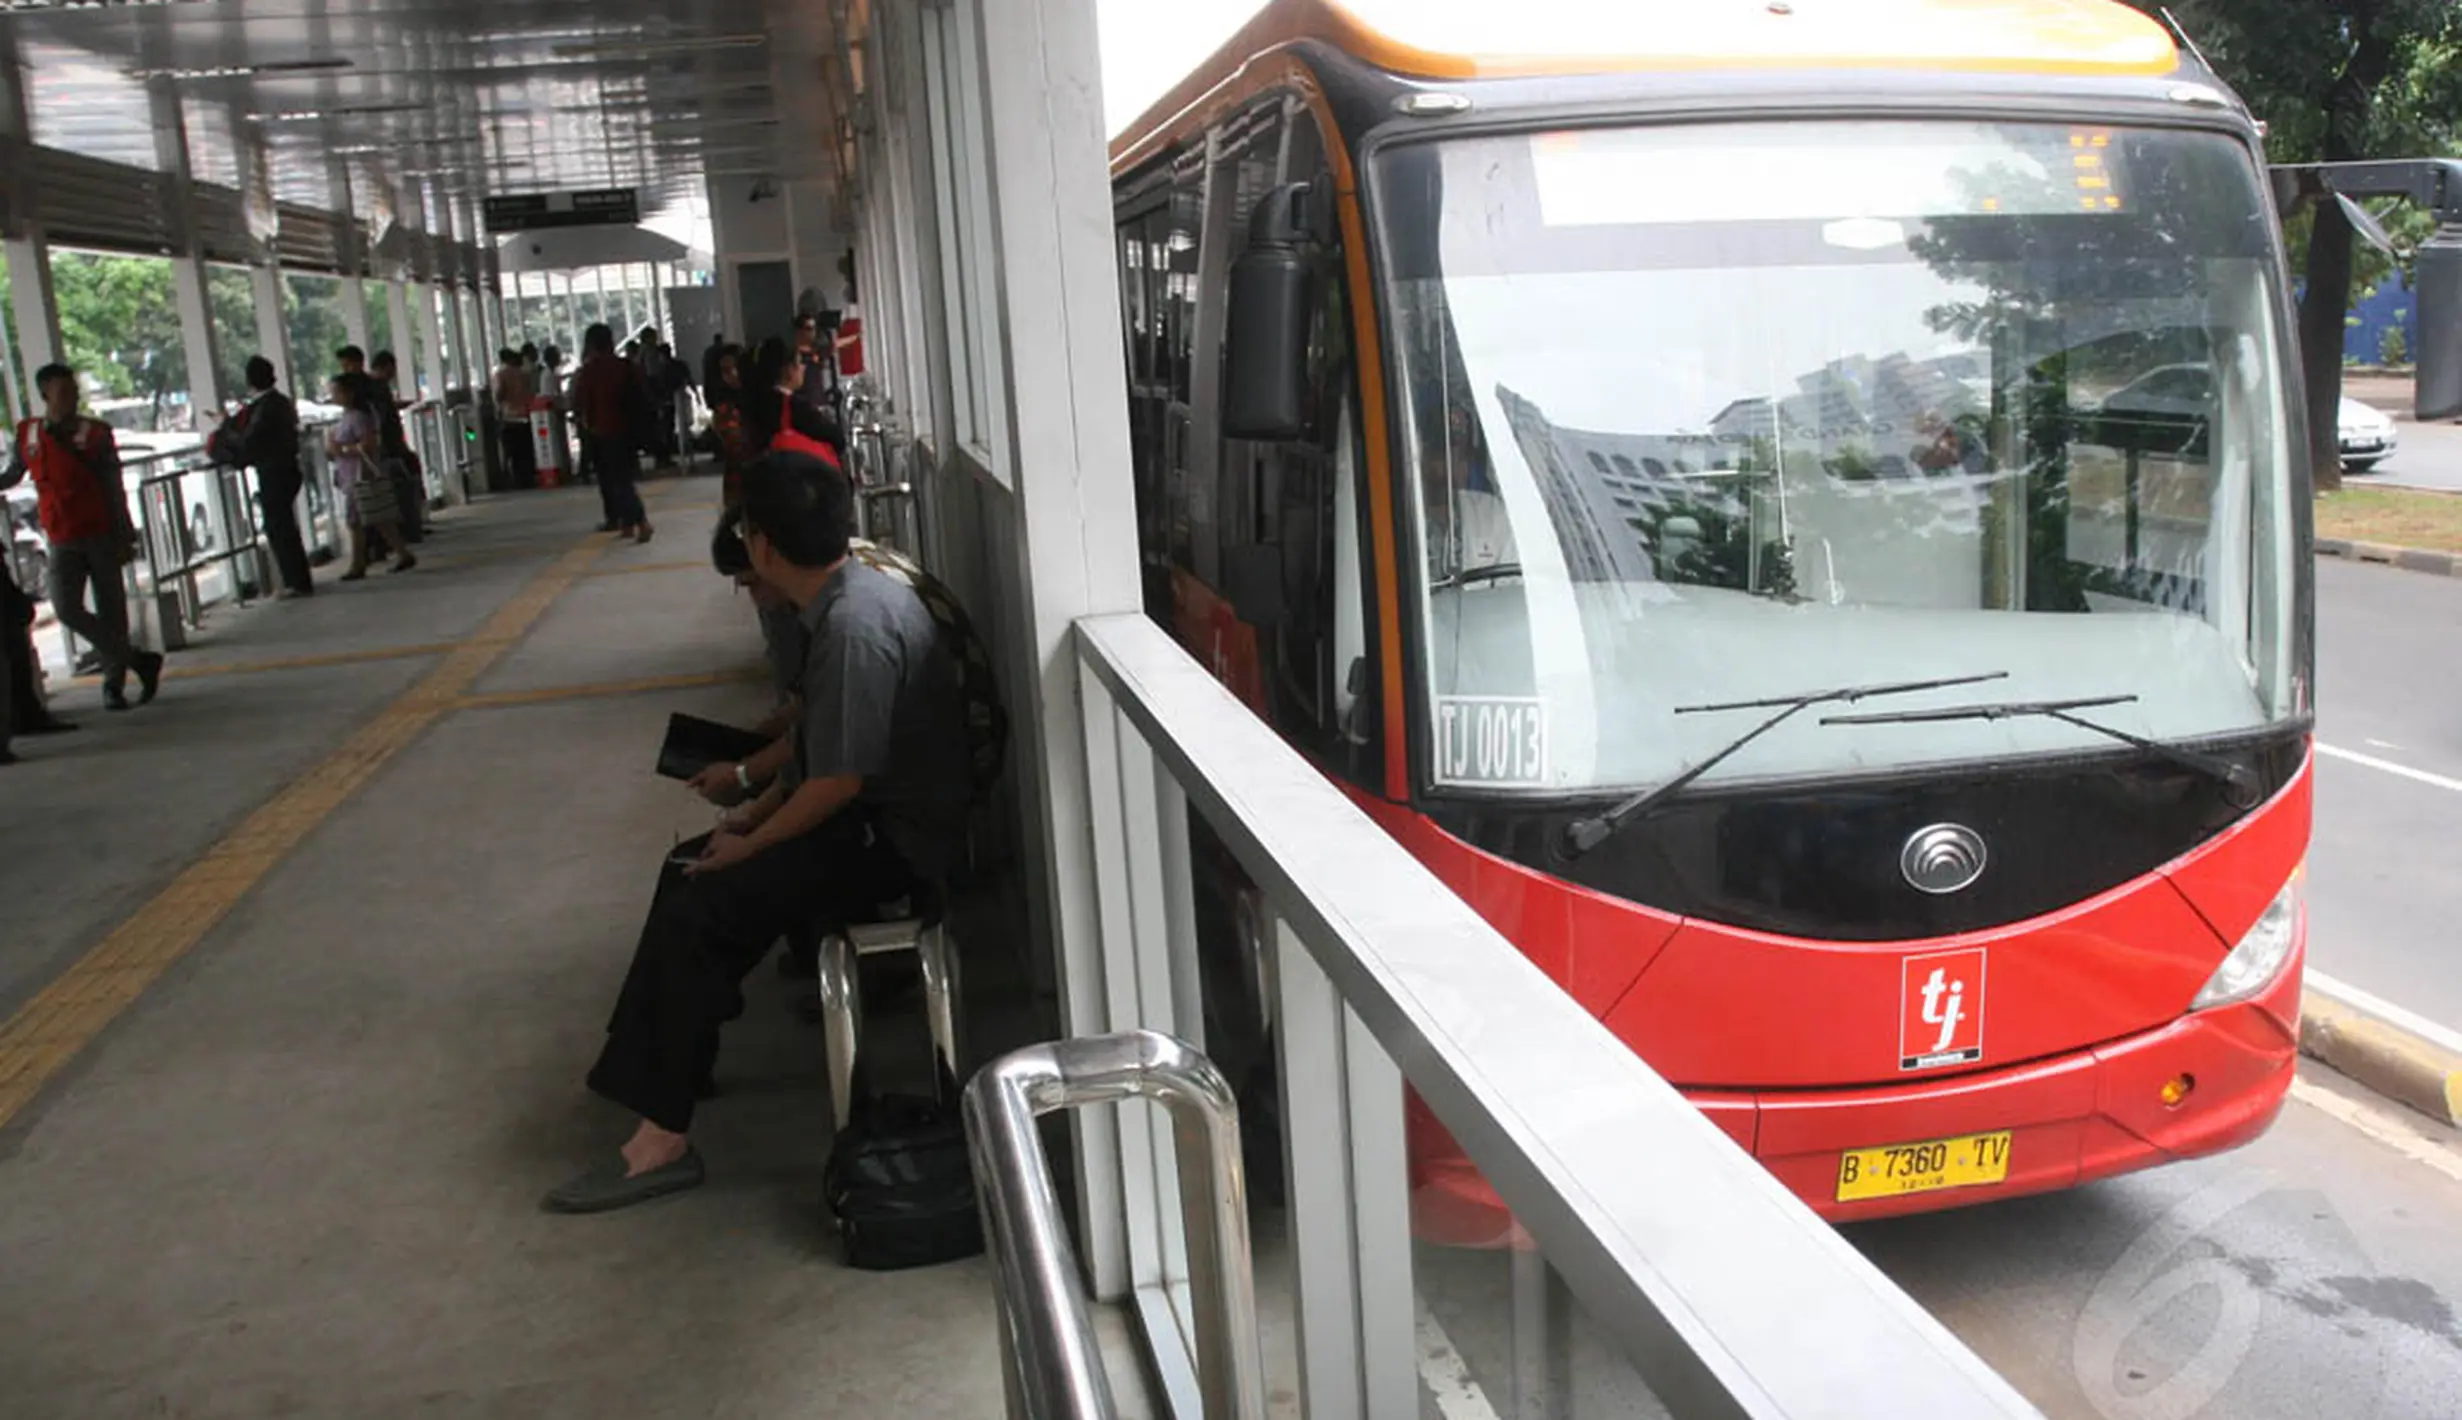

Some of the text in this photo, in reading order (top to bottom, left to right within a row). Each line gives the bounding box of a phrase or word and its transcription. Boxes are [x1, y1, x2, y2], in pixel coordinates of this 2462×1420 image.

[1441, 704, 1540, 778] TJ 0013
[1921, 967, 1966, 1052] tj
[1843, 1137, 2008, 1184] B 7360 TV
